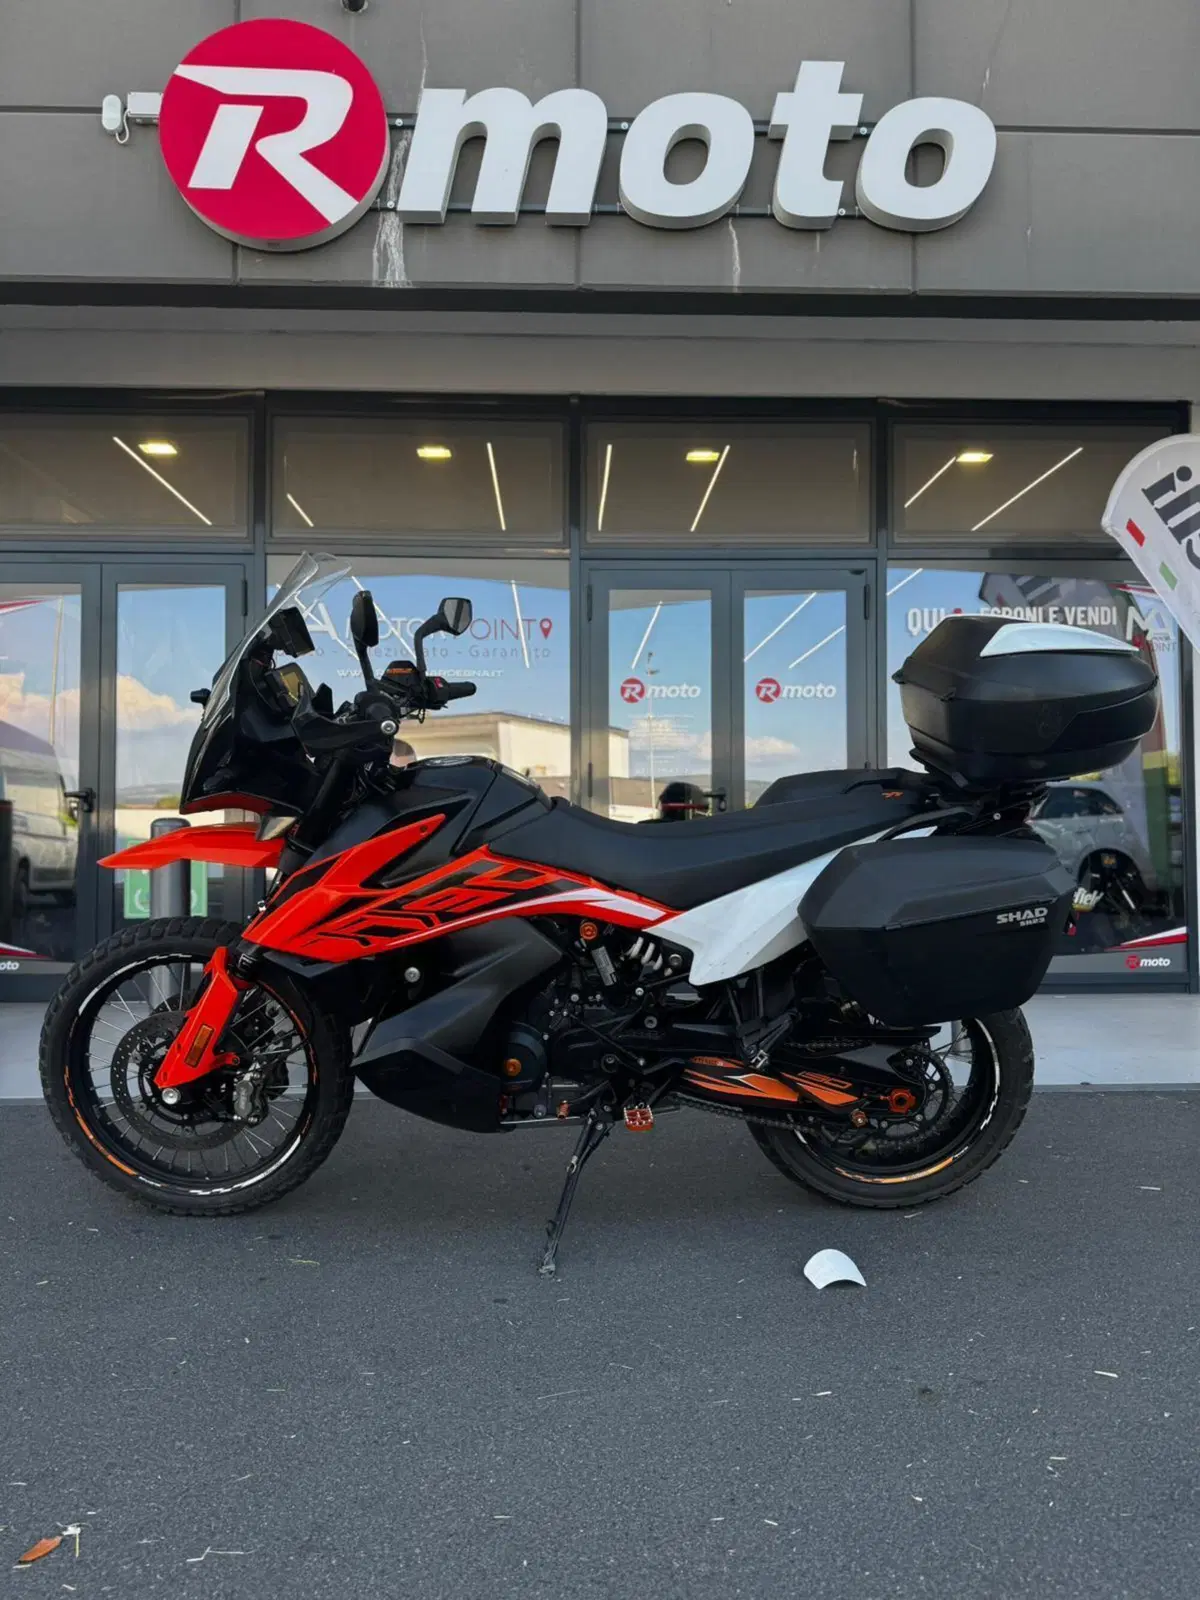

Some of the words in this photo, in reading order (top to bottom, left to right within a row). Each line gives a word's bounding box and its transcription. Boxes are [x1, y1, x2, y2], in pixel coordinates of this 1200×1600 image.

[398, 60, 997, 231] moto
[1049, 606, 1060, 624] E
[1064, 606, 1117, 625] VENDI
[647, 682, 701, 699] moto
[782, 682, 837, 699] moto
[996, 907, 1049, 924] SHAD
[1139, 957, 1171, 968] moto
